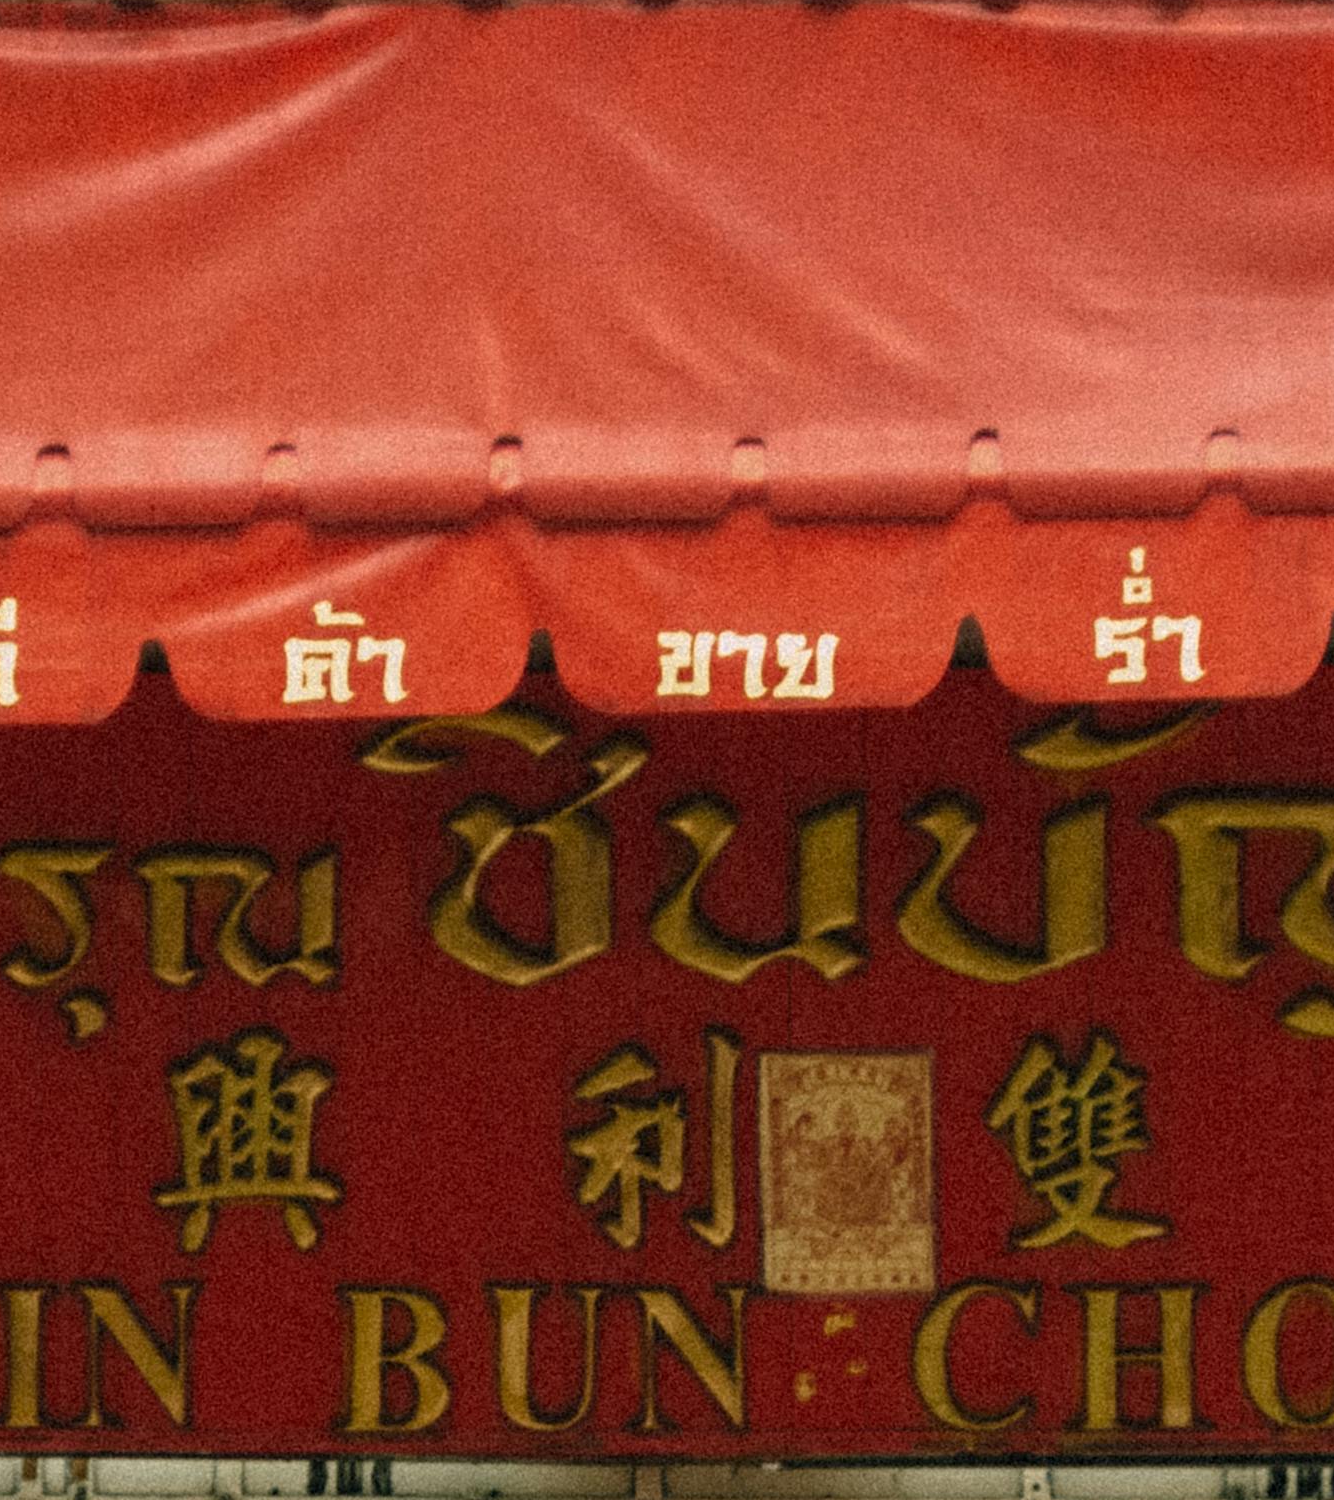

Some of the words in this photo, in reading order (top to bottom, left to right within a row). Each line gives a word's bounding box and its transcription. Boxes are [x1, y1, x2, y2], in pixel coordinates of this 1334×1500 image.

[284, 601, 408, 702] ค้า
[657, 631, 838, 699] ขาย
[1095, 547, 1204, 684] ร่ำ
[339, 1285, 747, 1432] BUN
